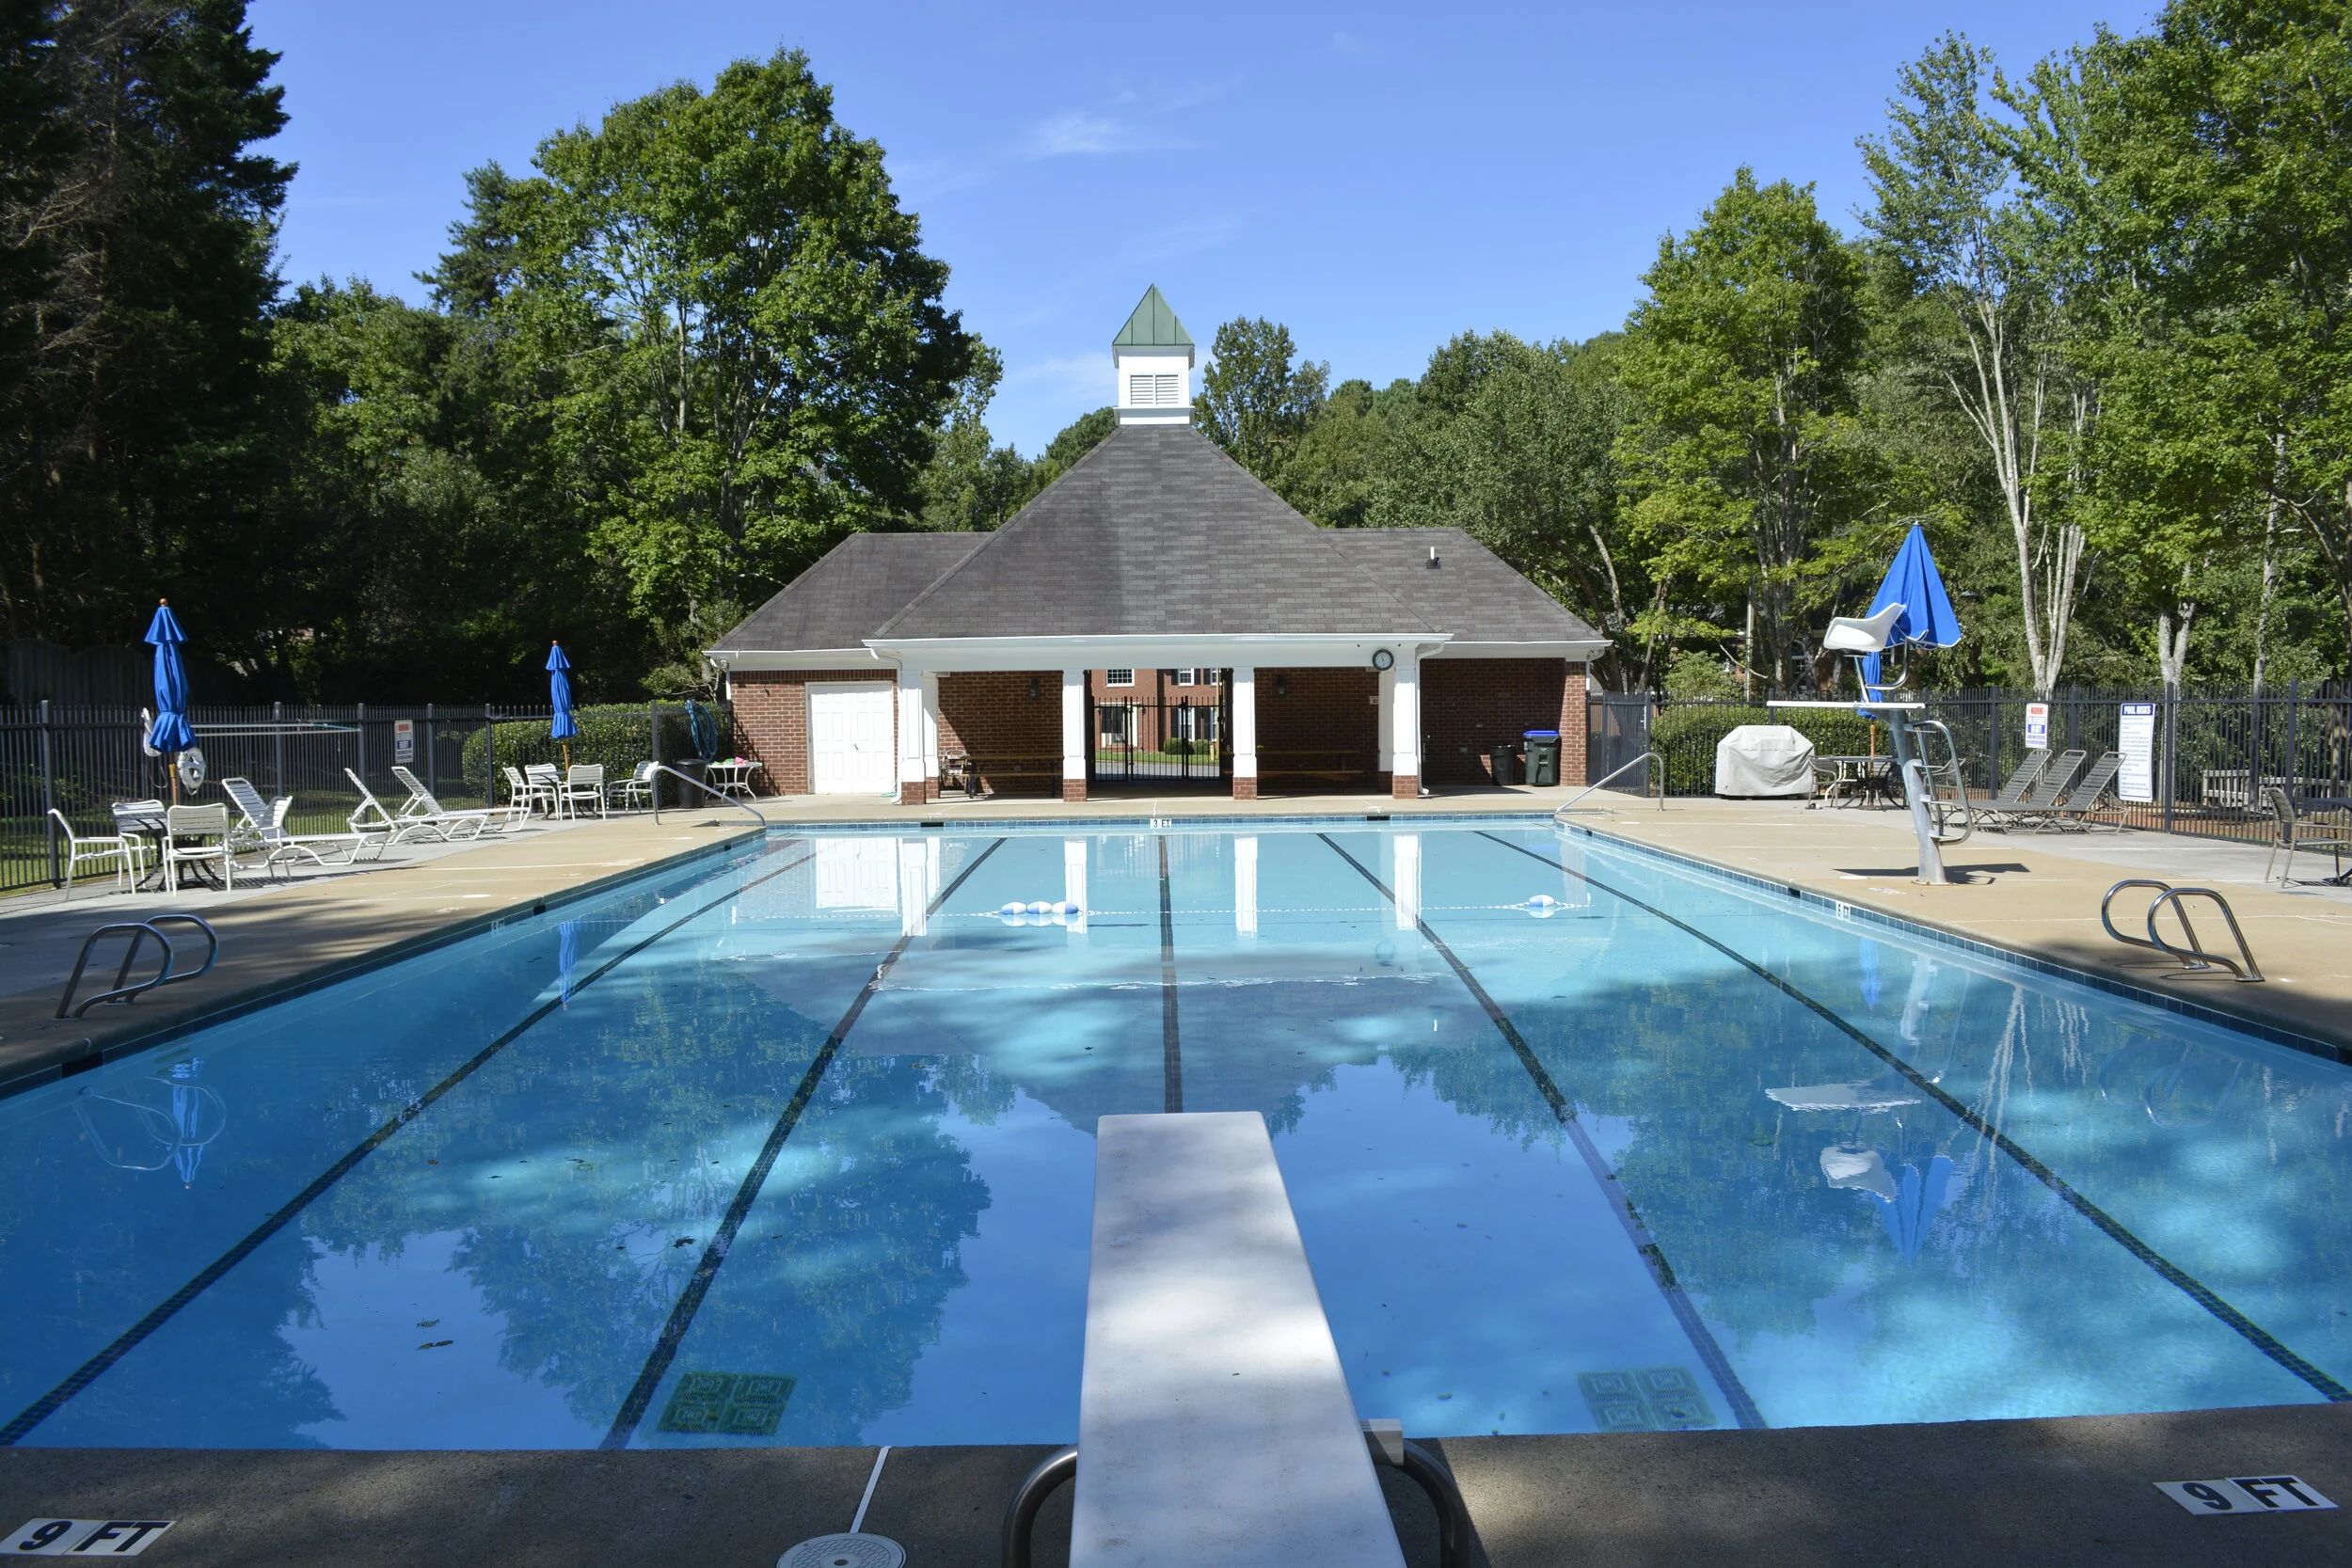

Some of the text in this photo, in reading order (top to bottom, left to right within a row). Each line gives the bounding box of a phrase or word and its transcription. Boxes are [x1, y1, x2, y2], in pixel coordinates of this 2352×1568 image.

[2182, 1476, 2321, 1511] 9 FT
[19, 1520, 172, 1552] 9 FT
